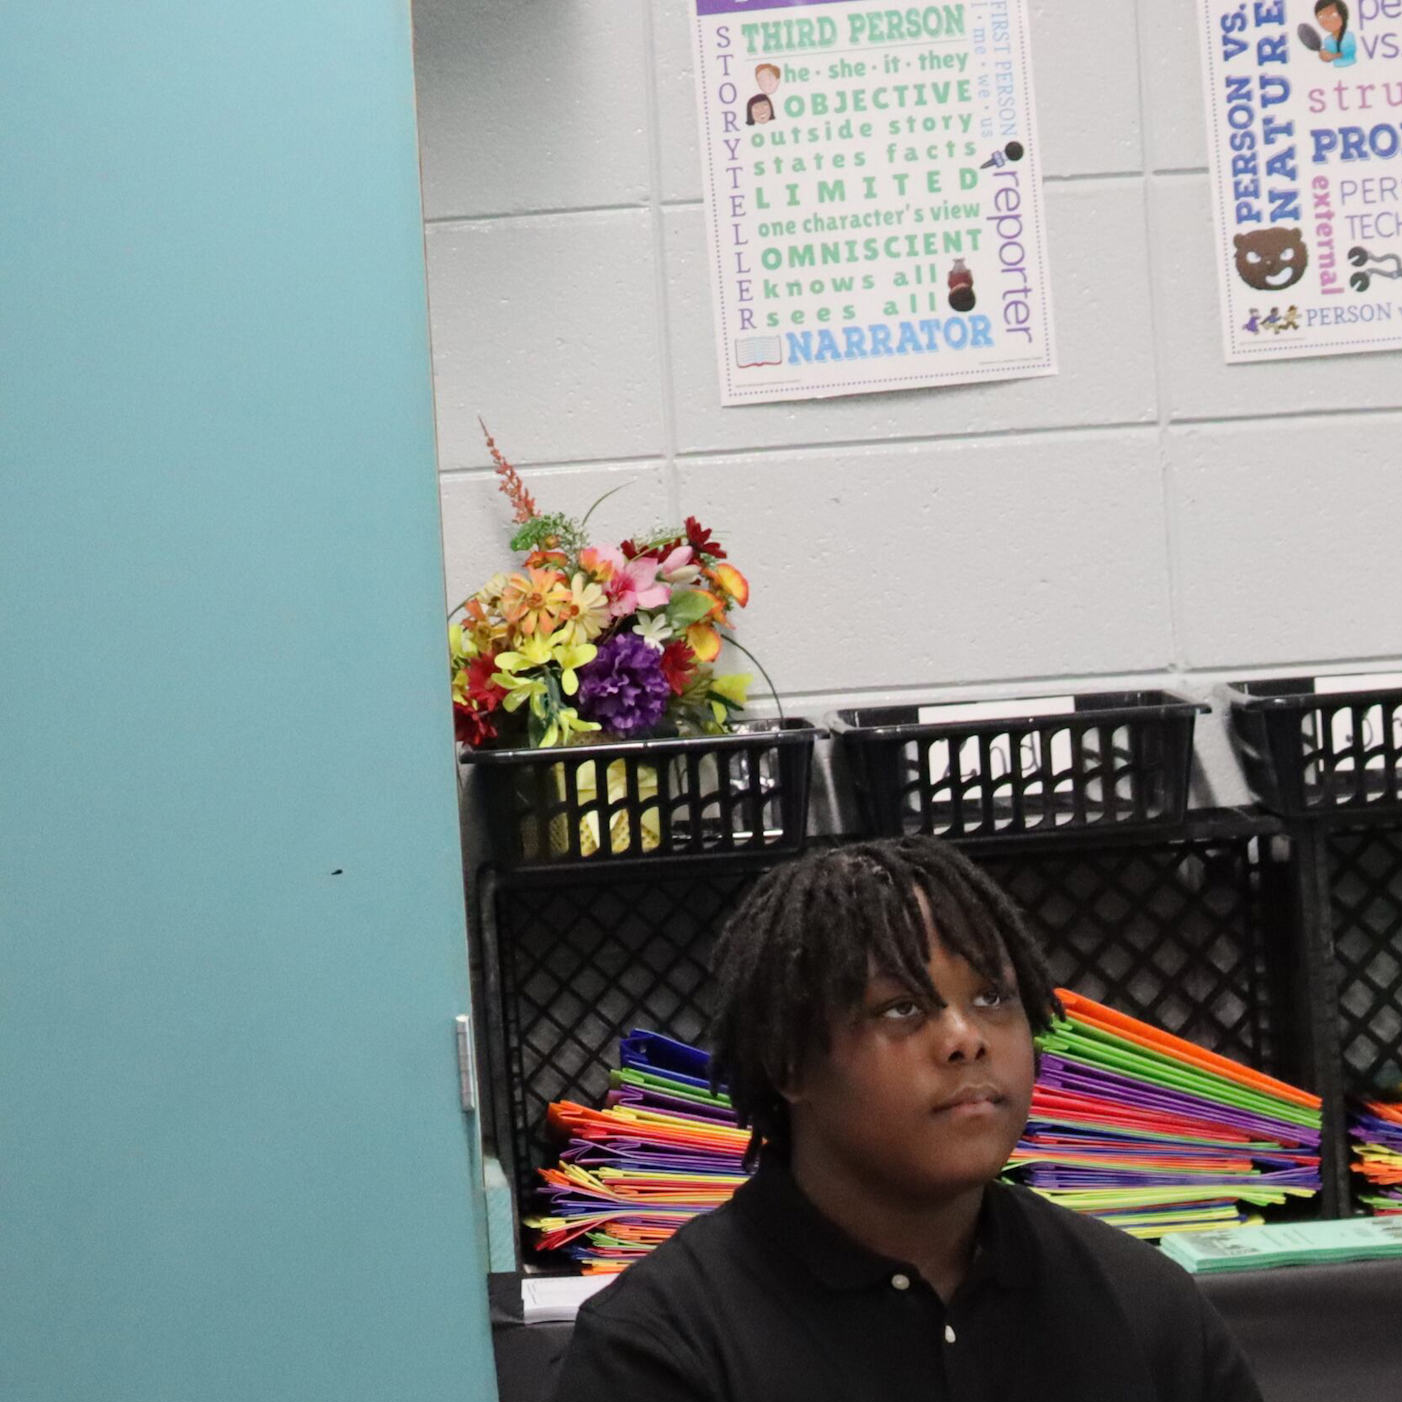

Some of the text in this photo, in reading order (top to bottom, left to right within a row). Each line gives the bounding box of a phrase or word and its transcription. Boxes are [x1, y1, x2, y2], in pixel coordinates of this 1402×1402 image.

[742, 4, 965, 55] THIRD PERSON
[973, 28, 986, 54] me
[784, 51, 969, 84] he she it they
[978, 74, 990, 98] we
[990, 1, 1017, 136] FIRST PERSON
[784, 79, 972, 117] OBJECTIVE
[1221, 4, 1262, 225] PERSON VS.
[1254, 0, 1302, 223] NATURE
[751, 112, 973, 148] outside story
[981, 117, 992, 137] us
[754, 141, 976, 176] states facts
[716, 26, 757, 330] STORYTELLER
[756, 168, 978, 209] LIMITED
[758, 200, 981, 237] one character's view
[1311, 175, 1345, 295] external
[761, 229, 982, 271] OMNISCIENT
[986, 171, 1033, 343] reporter
[763, 264, 937, 299] knows all
[766, 293, 936, 327] sees all
[1306, 302, 1392, 327] PERSON
[786, 314, 994, 366] NARRATOR
